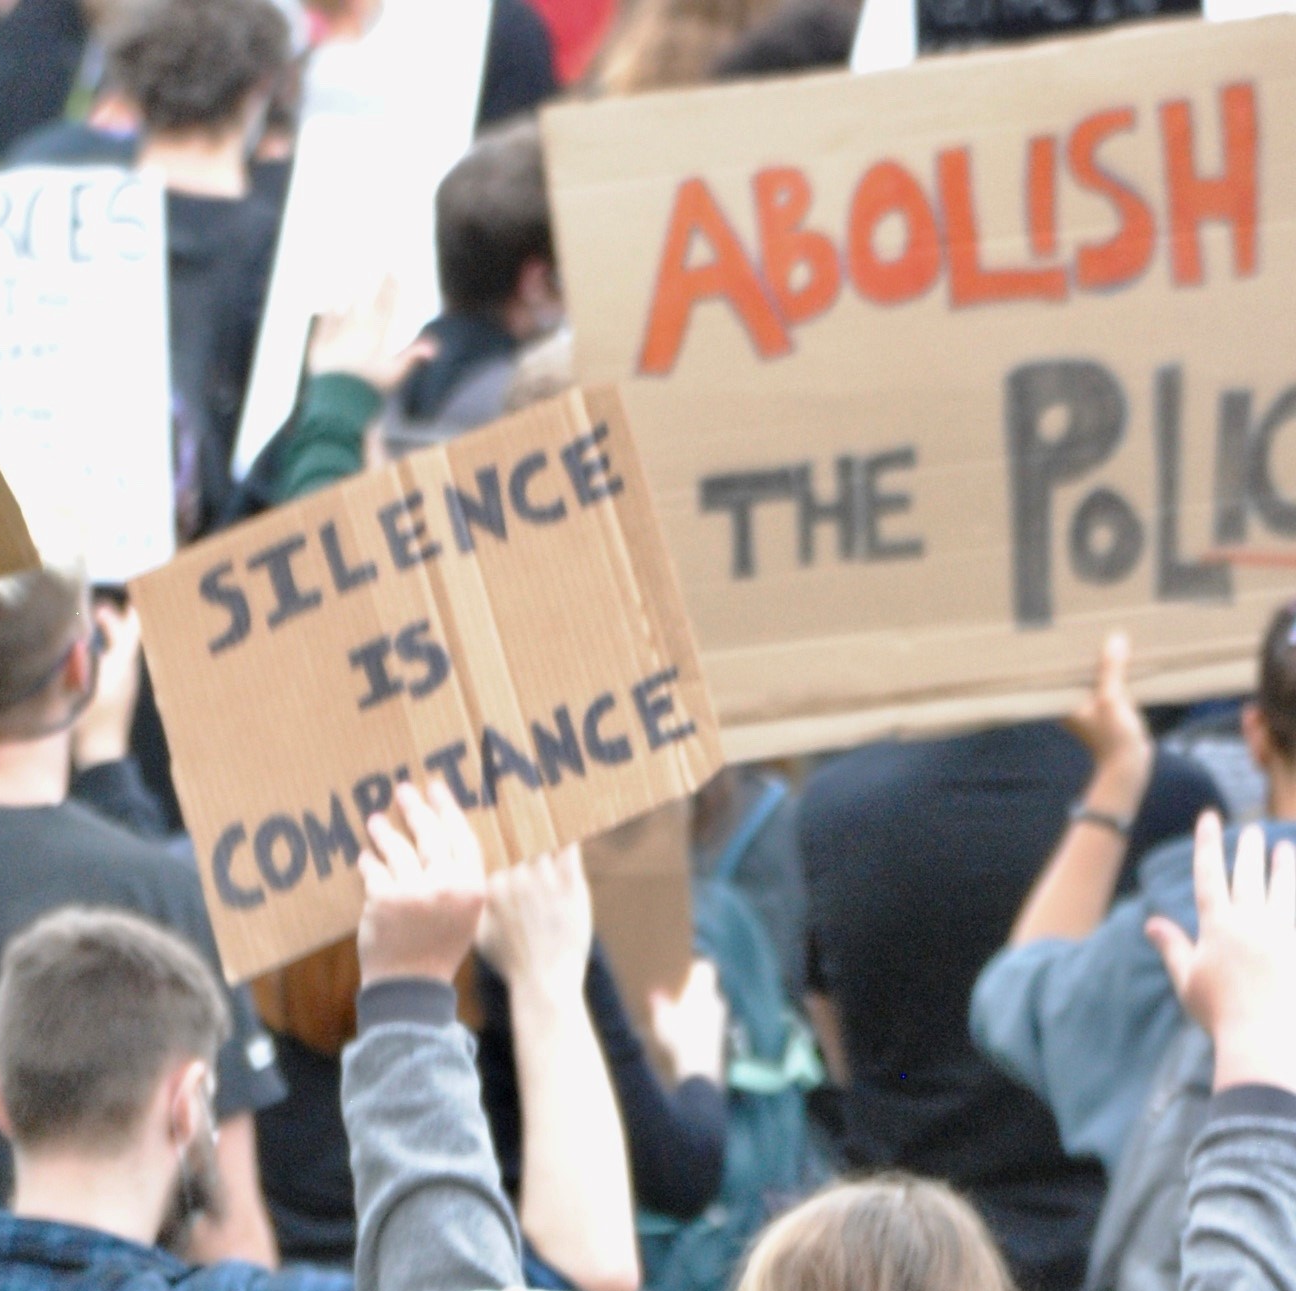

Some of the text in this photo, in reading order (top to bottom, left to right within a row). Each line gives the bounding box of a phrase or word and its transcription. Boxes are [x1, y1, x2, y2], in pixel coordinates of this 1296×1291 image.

[636, 82, 1258, 378] ABOLISH
[198, 424, 625, 659] SILENCE
[697, 445, 924, 581] THE
[348, 620, 451, 714] IS
[211, 667, 696, 911] COMPIANCE
